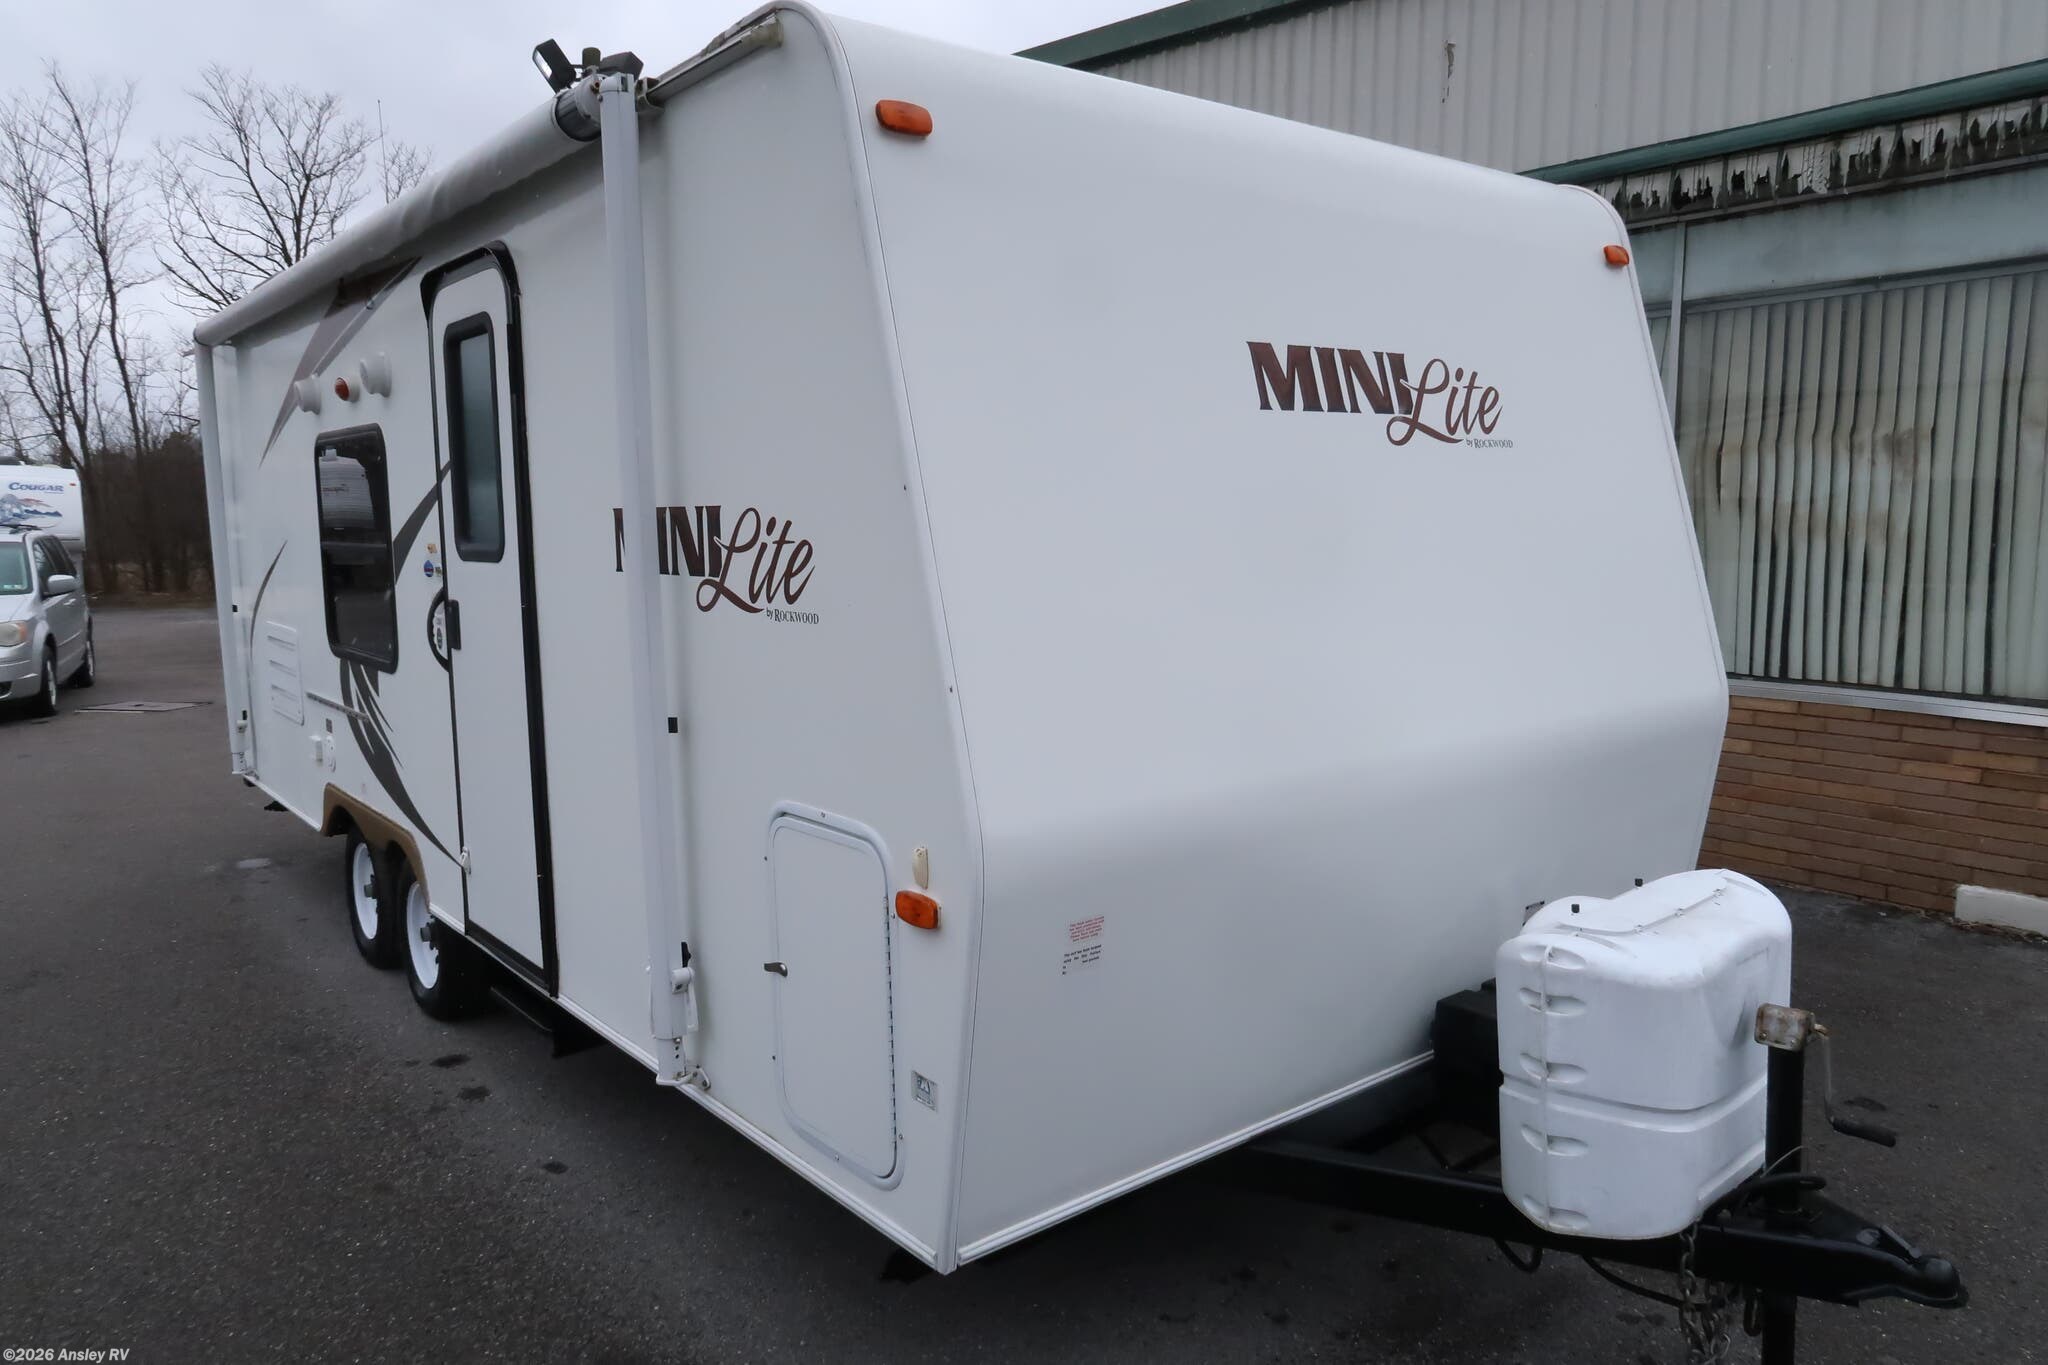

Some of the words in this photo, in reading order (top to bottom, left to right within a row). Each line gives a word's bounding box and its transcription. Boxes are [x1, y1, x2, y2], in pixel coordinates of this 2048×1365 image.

[1246, 341, 1413, 415] MINI
[1386, 358, 1503, 446] Lite
[1466, 438, 1473, 448] by
[1473, 438, 1514, 449] ROCKWOOD
[613, 505, 722, 578] INI
[696, 507, 816, 613] Lite
[766, 607, 774, 620] by
[774, 608, 820, 625] ROCKWOOD
